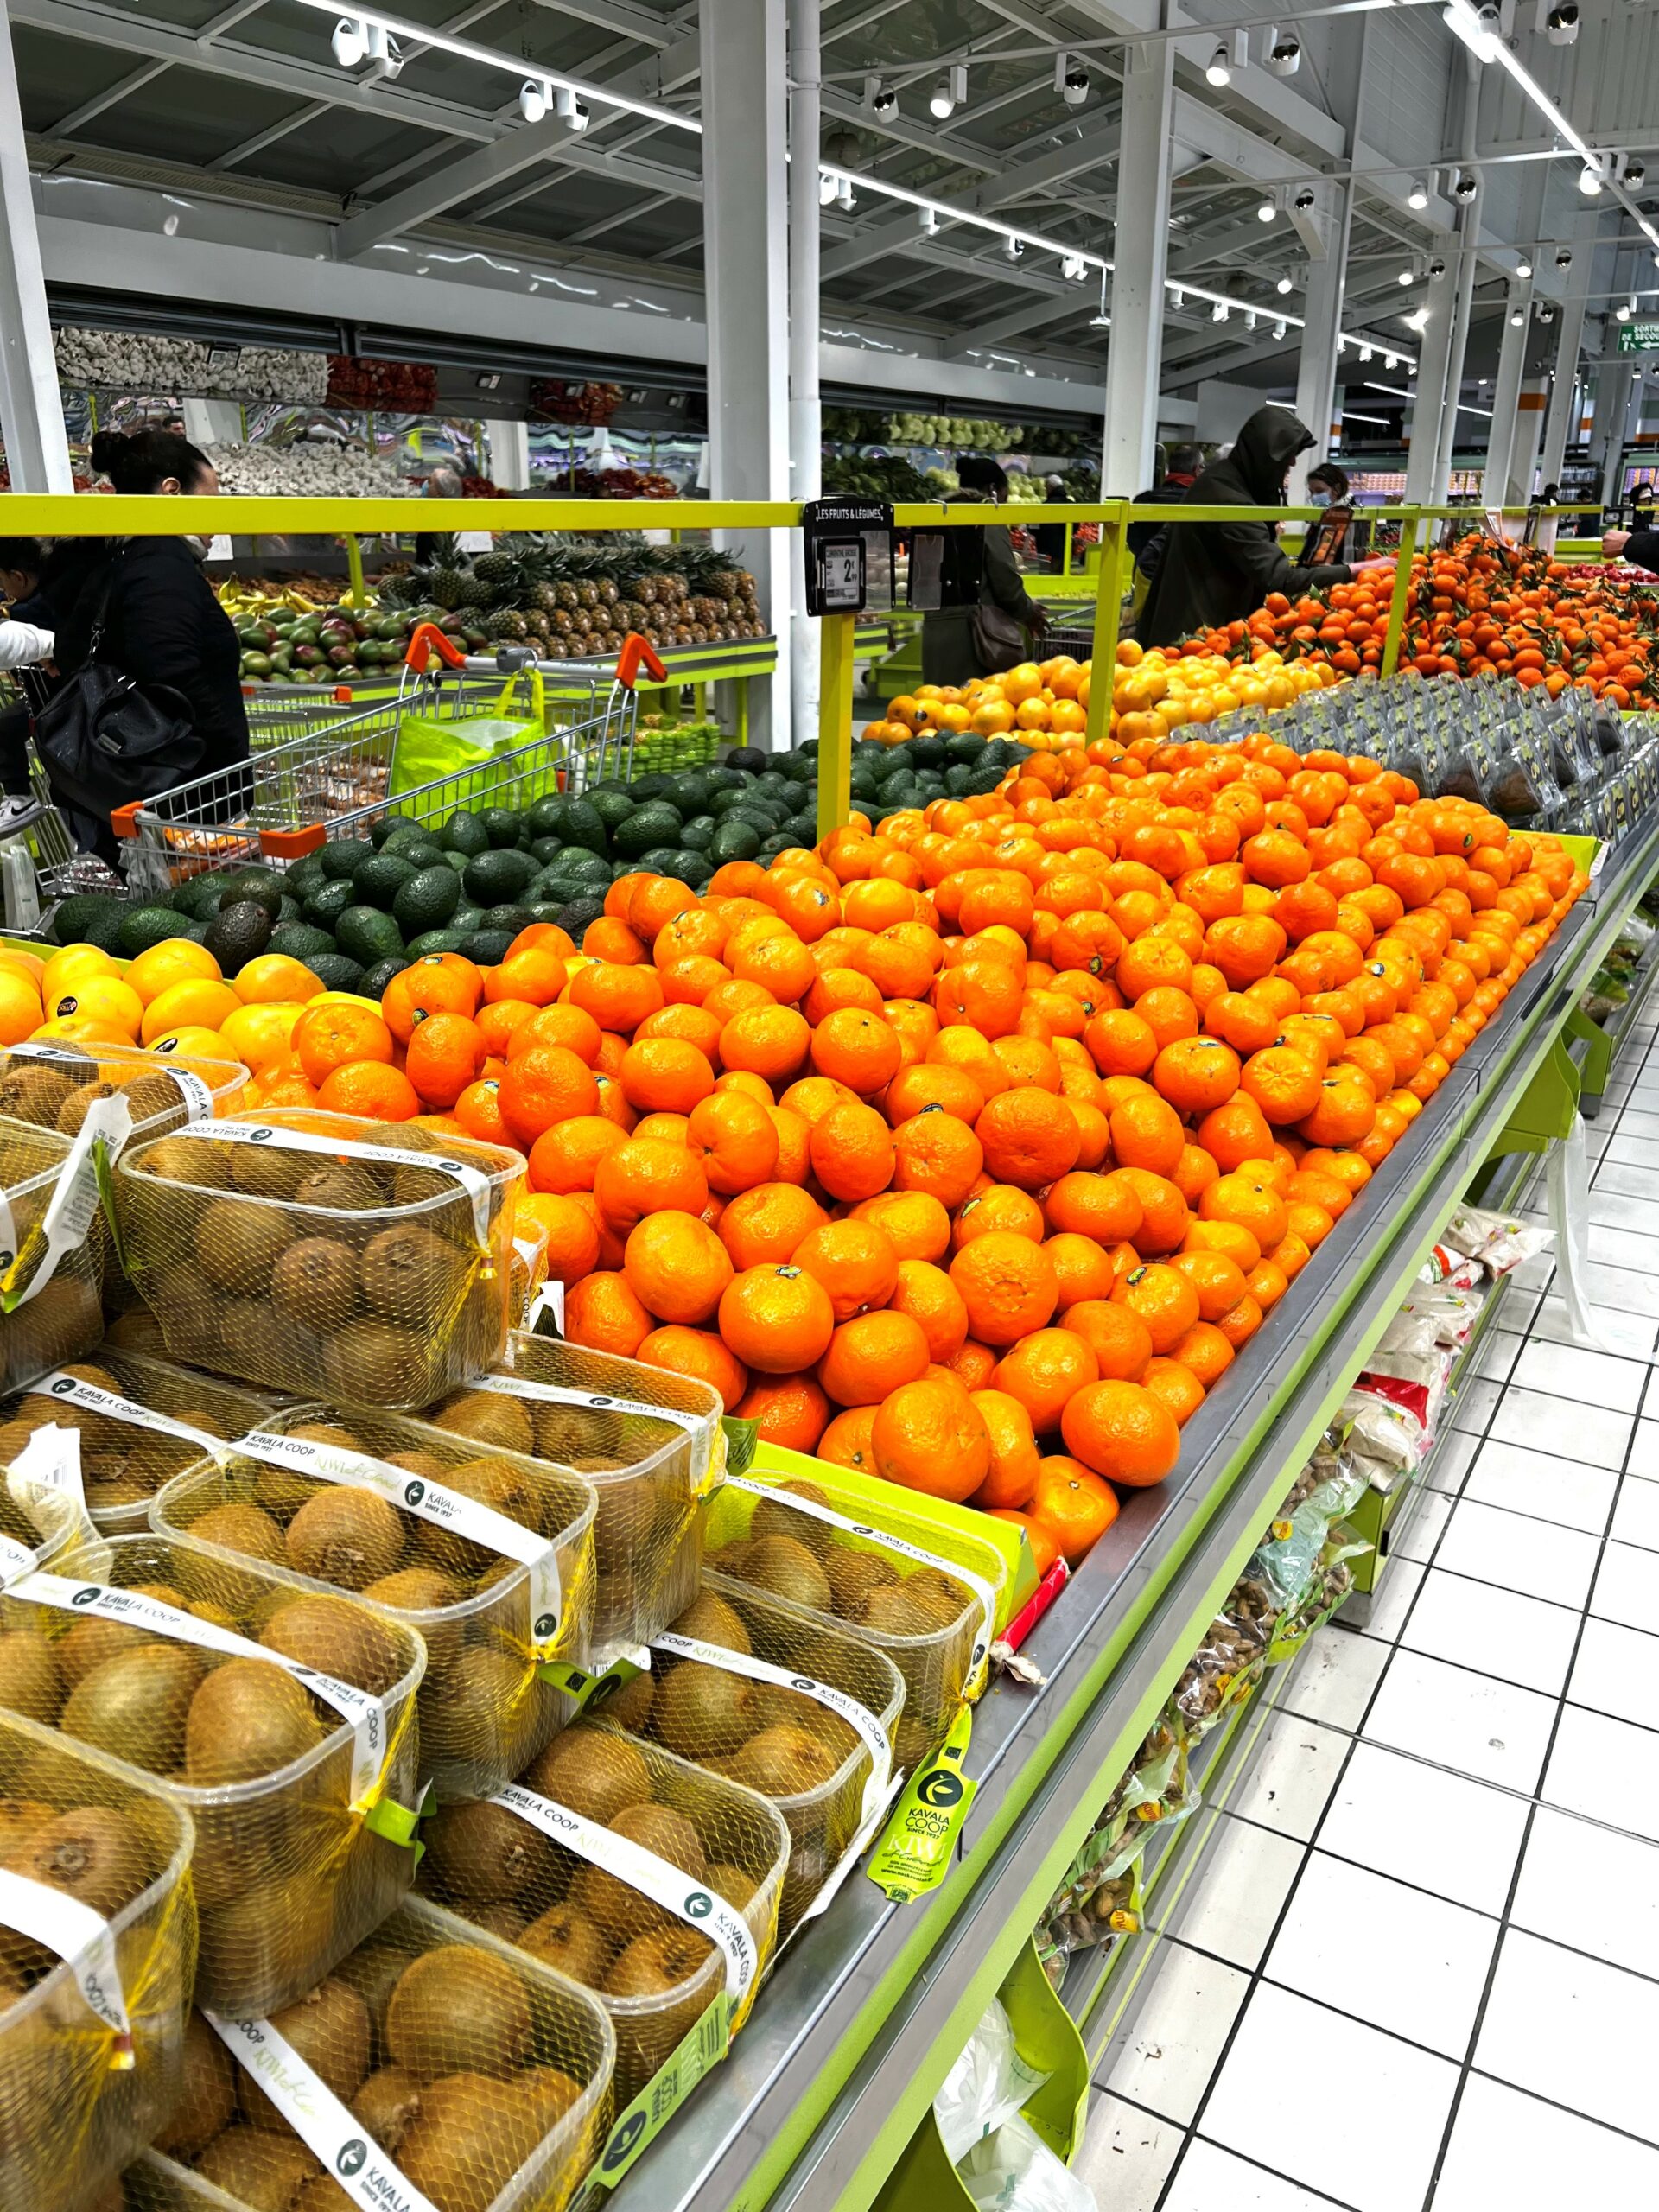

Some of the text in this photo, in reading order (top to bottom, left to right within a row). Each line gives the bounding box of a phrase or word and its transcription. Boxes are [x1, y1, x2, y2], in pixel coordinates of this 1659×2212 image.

[817, 505, 881, 519] LES FRUITS & LÉGUMES
[187, 1077, 207, 1111] KAVALA
[213, 1128, 247, 1138] KAVALA
[77, 1387, 113, 1405] KAVALA
[114, 1402, 146, 1417] COOP
[249, 1433, 284, 1450] KAVALA
[285, 1442, 315, 1457] COOP
[101, 1593, 181, 1624] KAVALA COOP
[660, 1634, 724, 1662] COOP KIWI
[366, 1707, 378, 1750] COOP
[819, 1688, 886, 1750] KAVALA COOP
[502, 1788, 543, 1813] KAVALA
[543, 1808, 580, 1832] COOP
[908, 1808, 950, 1826] KAVALA
[905, 1816, 949, 1835] COOP
[906, 1827, 940, 1840] SINCE 1927
[887, 1833, 948, 1860] KIWI
[717, 1912, 748, 1961] KAVALA
[365, 2165, 410, 2212] KAVALA
